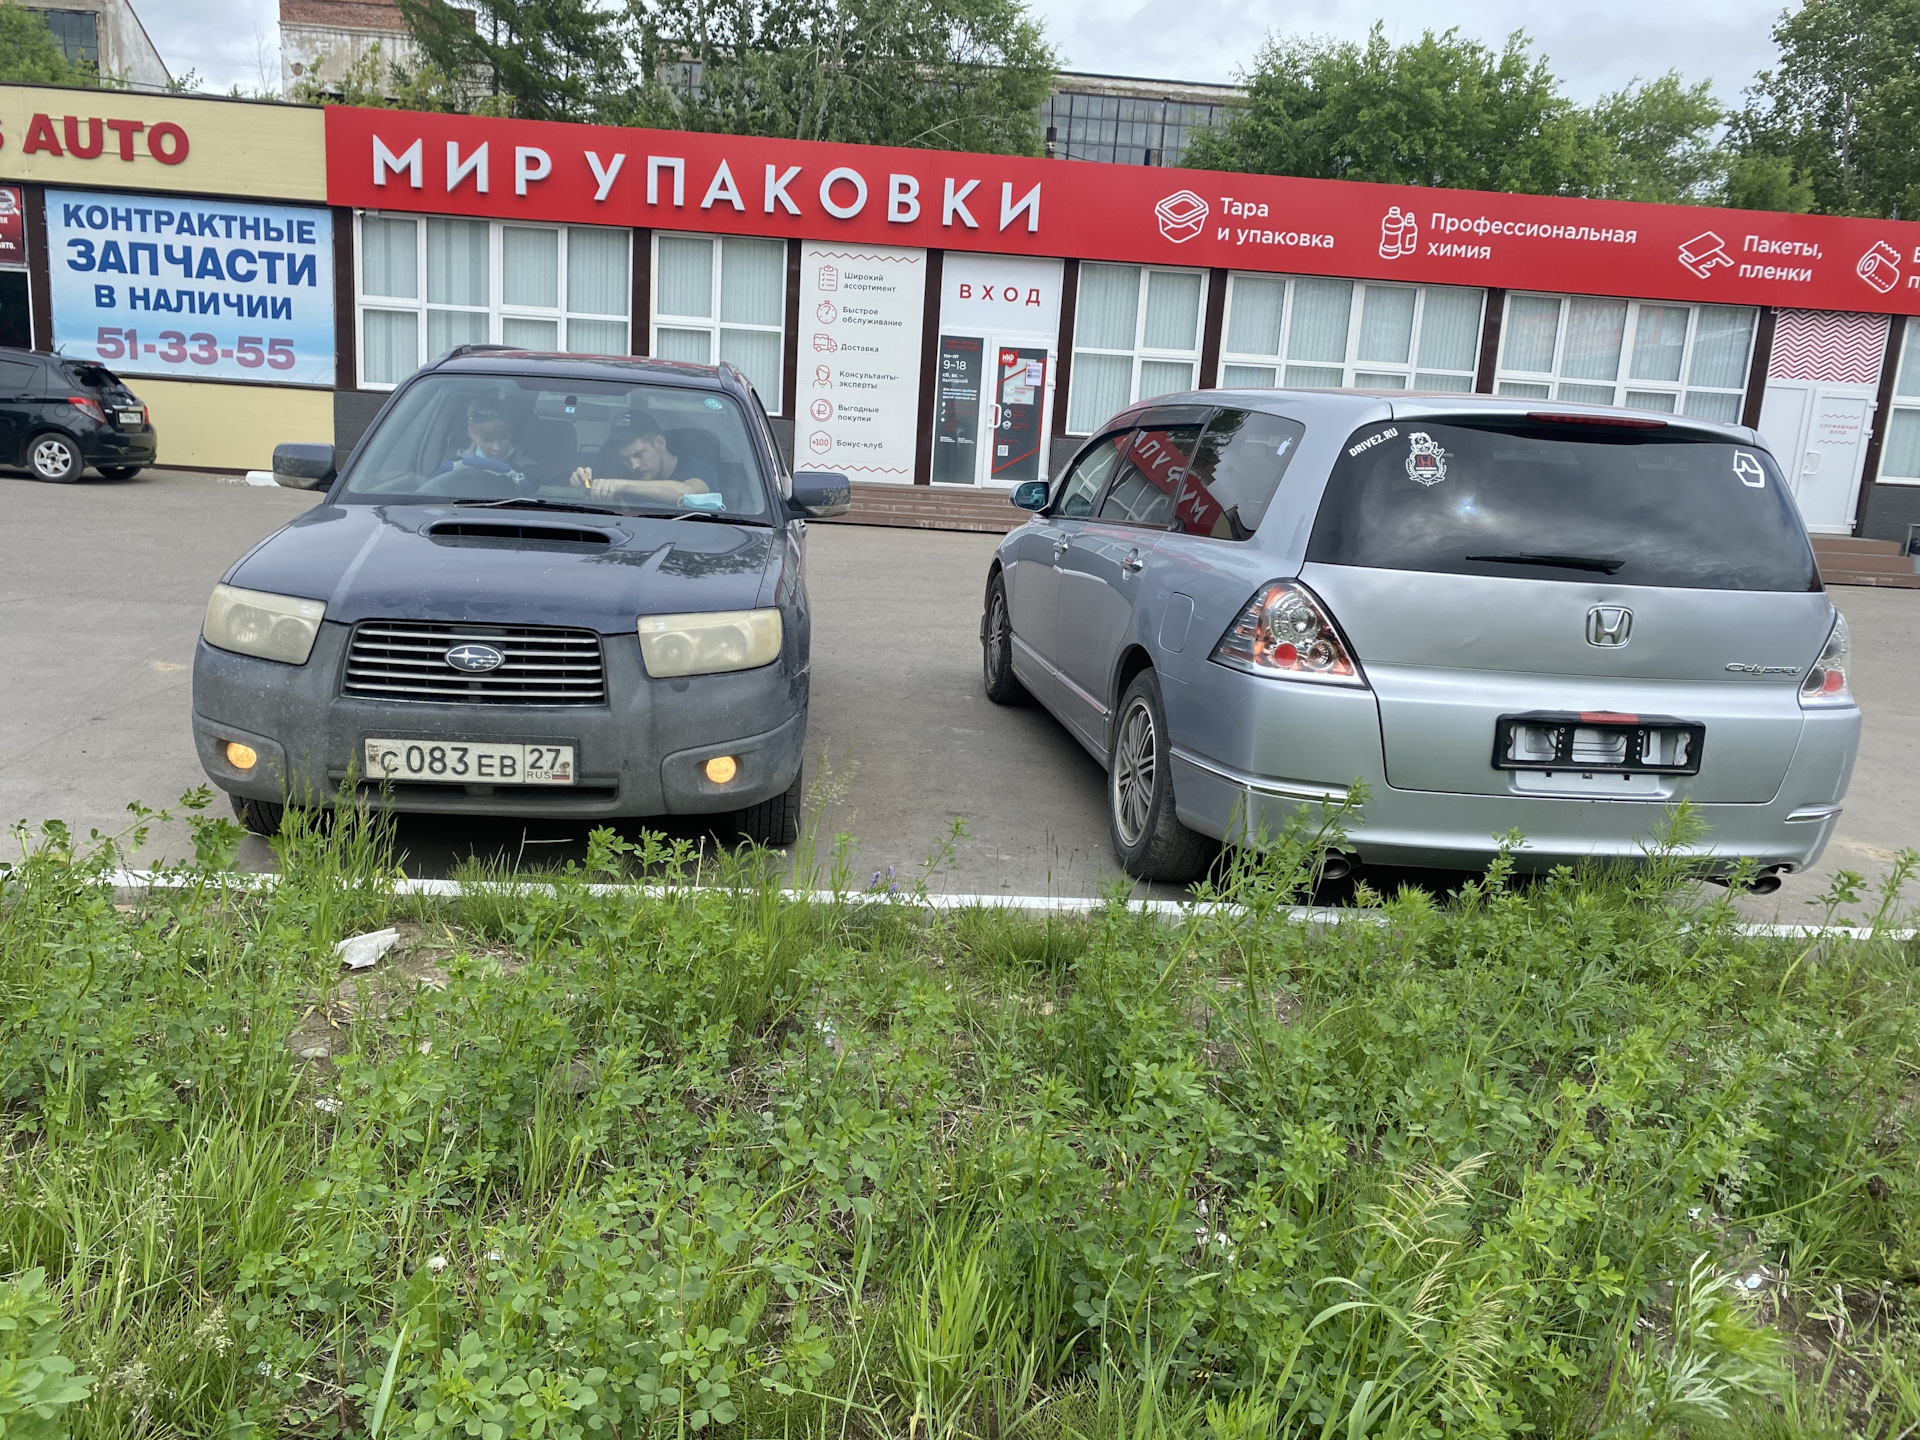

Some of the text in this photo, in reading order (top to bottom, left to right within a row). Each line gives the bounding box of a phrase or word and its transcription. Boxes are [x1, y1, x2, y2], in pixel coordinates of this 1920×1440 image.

[22, 112, 190, 165] AUTO
[372, 133, 1042, 233] МИР УПАКОВКИ
[1220, 197, 1269, 218] Тара
[63, 203, 316, 245] КОНТРАКТНЫЕ
[1430, 212, 1638, 244] Профессиональная
[1217, 226, 1335, 249] и упаковка
[1426, 242, 1492, 260] химия
[1743, 235, 1823, 260] Пакеты,
[66, 238, 317, 288] ЗАПЧАСТИ
[844, 272, 884, 282] Широкий
[1738, 264, 1812, 283] пленки
[843, 282, 896, 292] ассортимент
[959, 283, 1041, 307] ВХОД
[94, 284, 292, 321] В НАЛИЧИИ
[842, 306, 879, 316] Быстрое
[842, 316, 903, 327] обслуживание
[96, 327, 296, 371] 51-33-55
[840, 343, 879, 353] Доставка
[943, 359, 967, 371] 9-18
[839, 370, 899, 380] Консультанты-
[839, 381, 878, 389] эксперты
[838, 404, 880, 414] Выгодные
[836, 439, 883, 449] Бонус-клуб
[1348, 427, 1399, 458] DRIVE2.RU
[1725, 662, 1803, 676] Odyssey
[528, 747, 561, 771] 27
[526, 770, 551, 780] RUS
